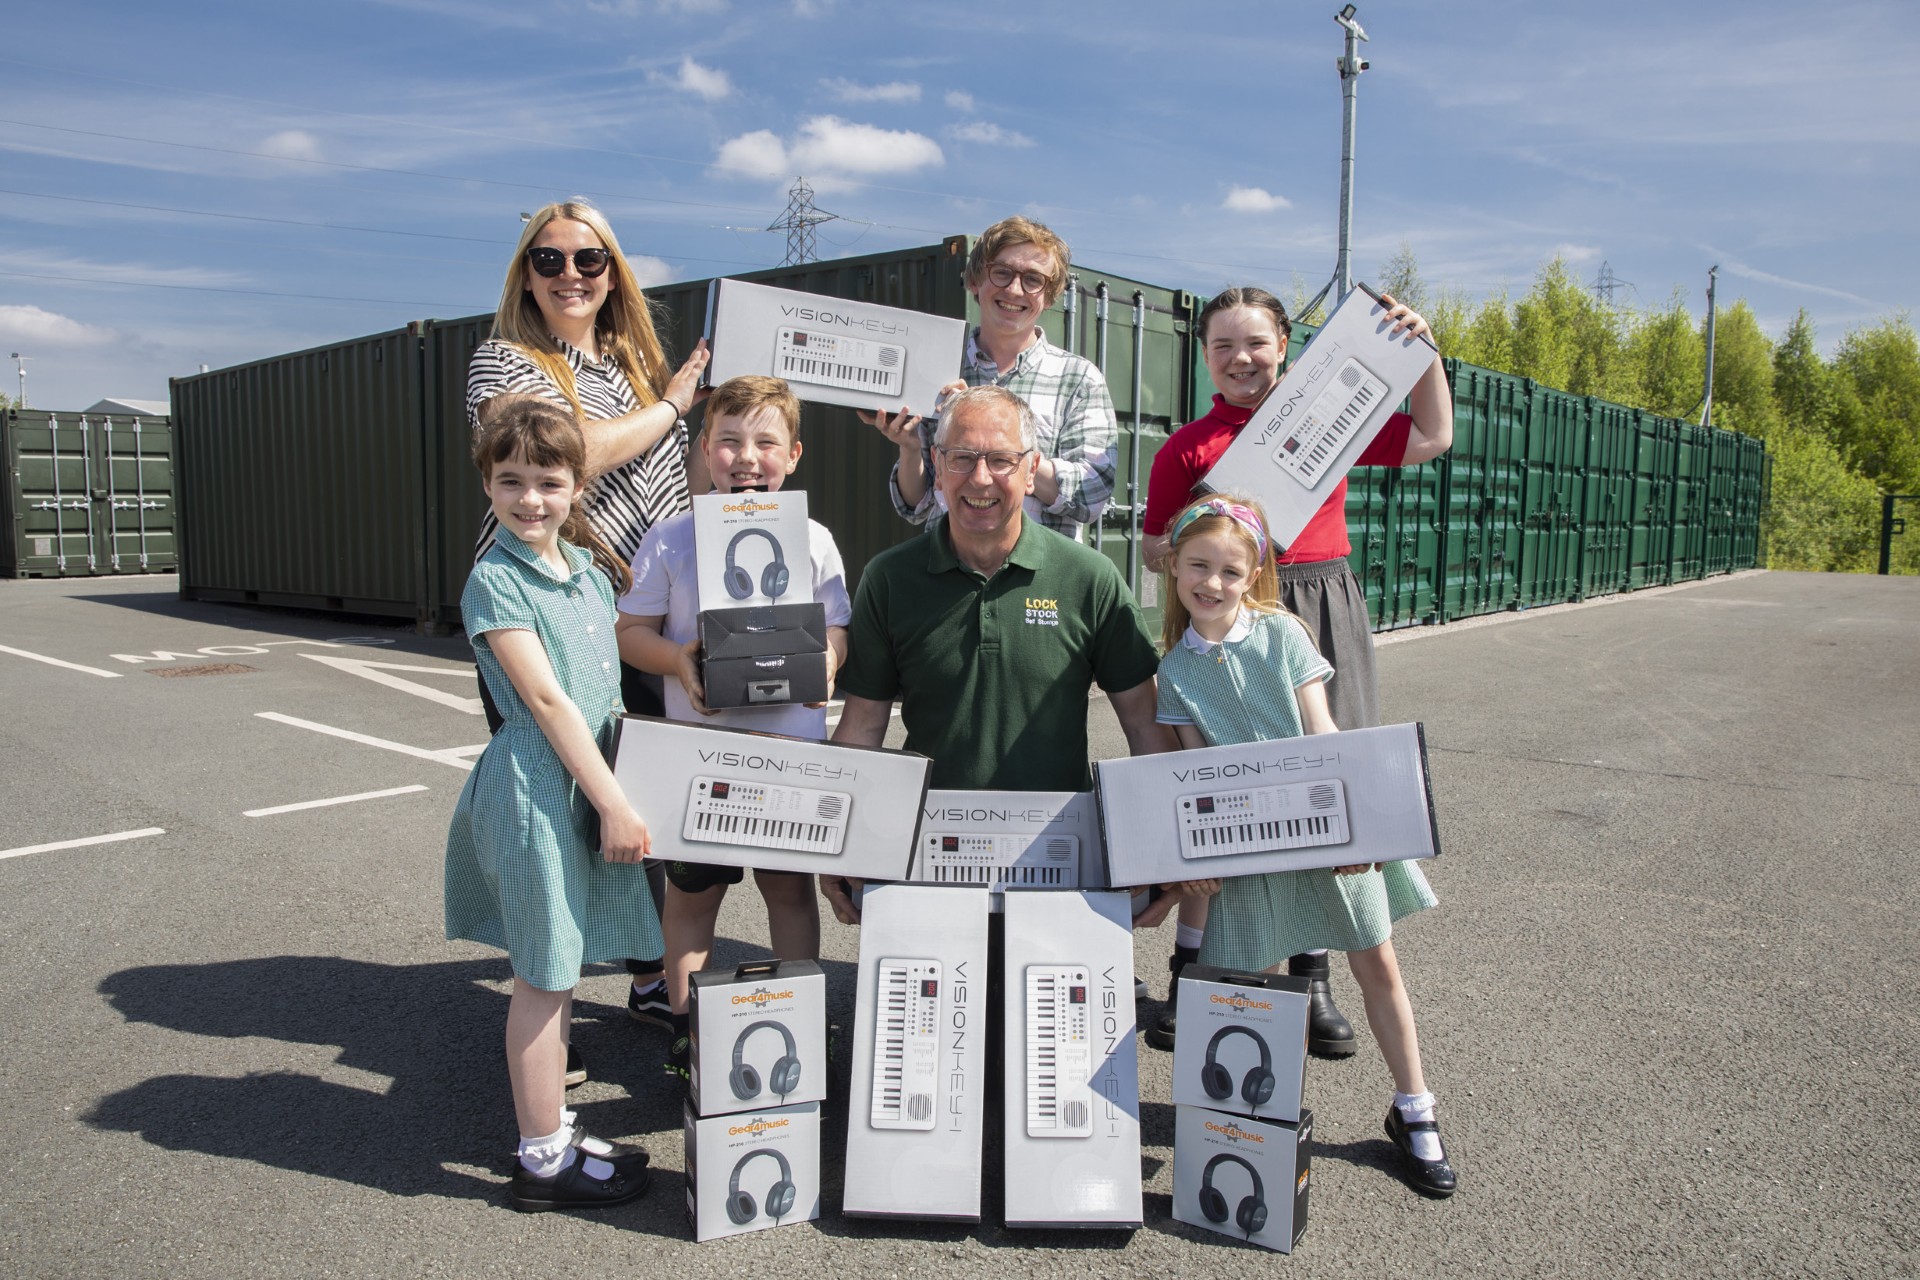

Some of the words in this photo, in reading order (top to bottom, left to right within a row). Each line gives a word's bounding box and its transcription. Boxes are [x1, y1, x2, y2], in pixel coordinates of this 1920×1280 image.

[723, 501, 779, 513] Gear4music
[1025, 598, 1058, 610] LOCK
[1025, 609, 1058, 618] STOCK
[1037, 618, 1059, 626] Storage
[731, 990, 793, 1005] Gear4music
[1209, 994, 1272, 1010] Gear4music
[765, 1006, 794, 1015] HEADPHONES
[728, 1118, 789, 1136] Gear4music
[1204, 1121, 1264, 1143] Gear4music
